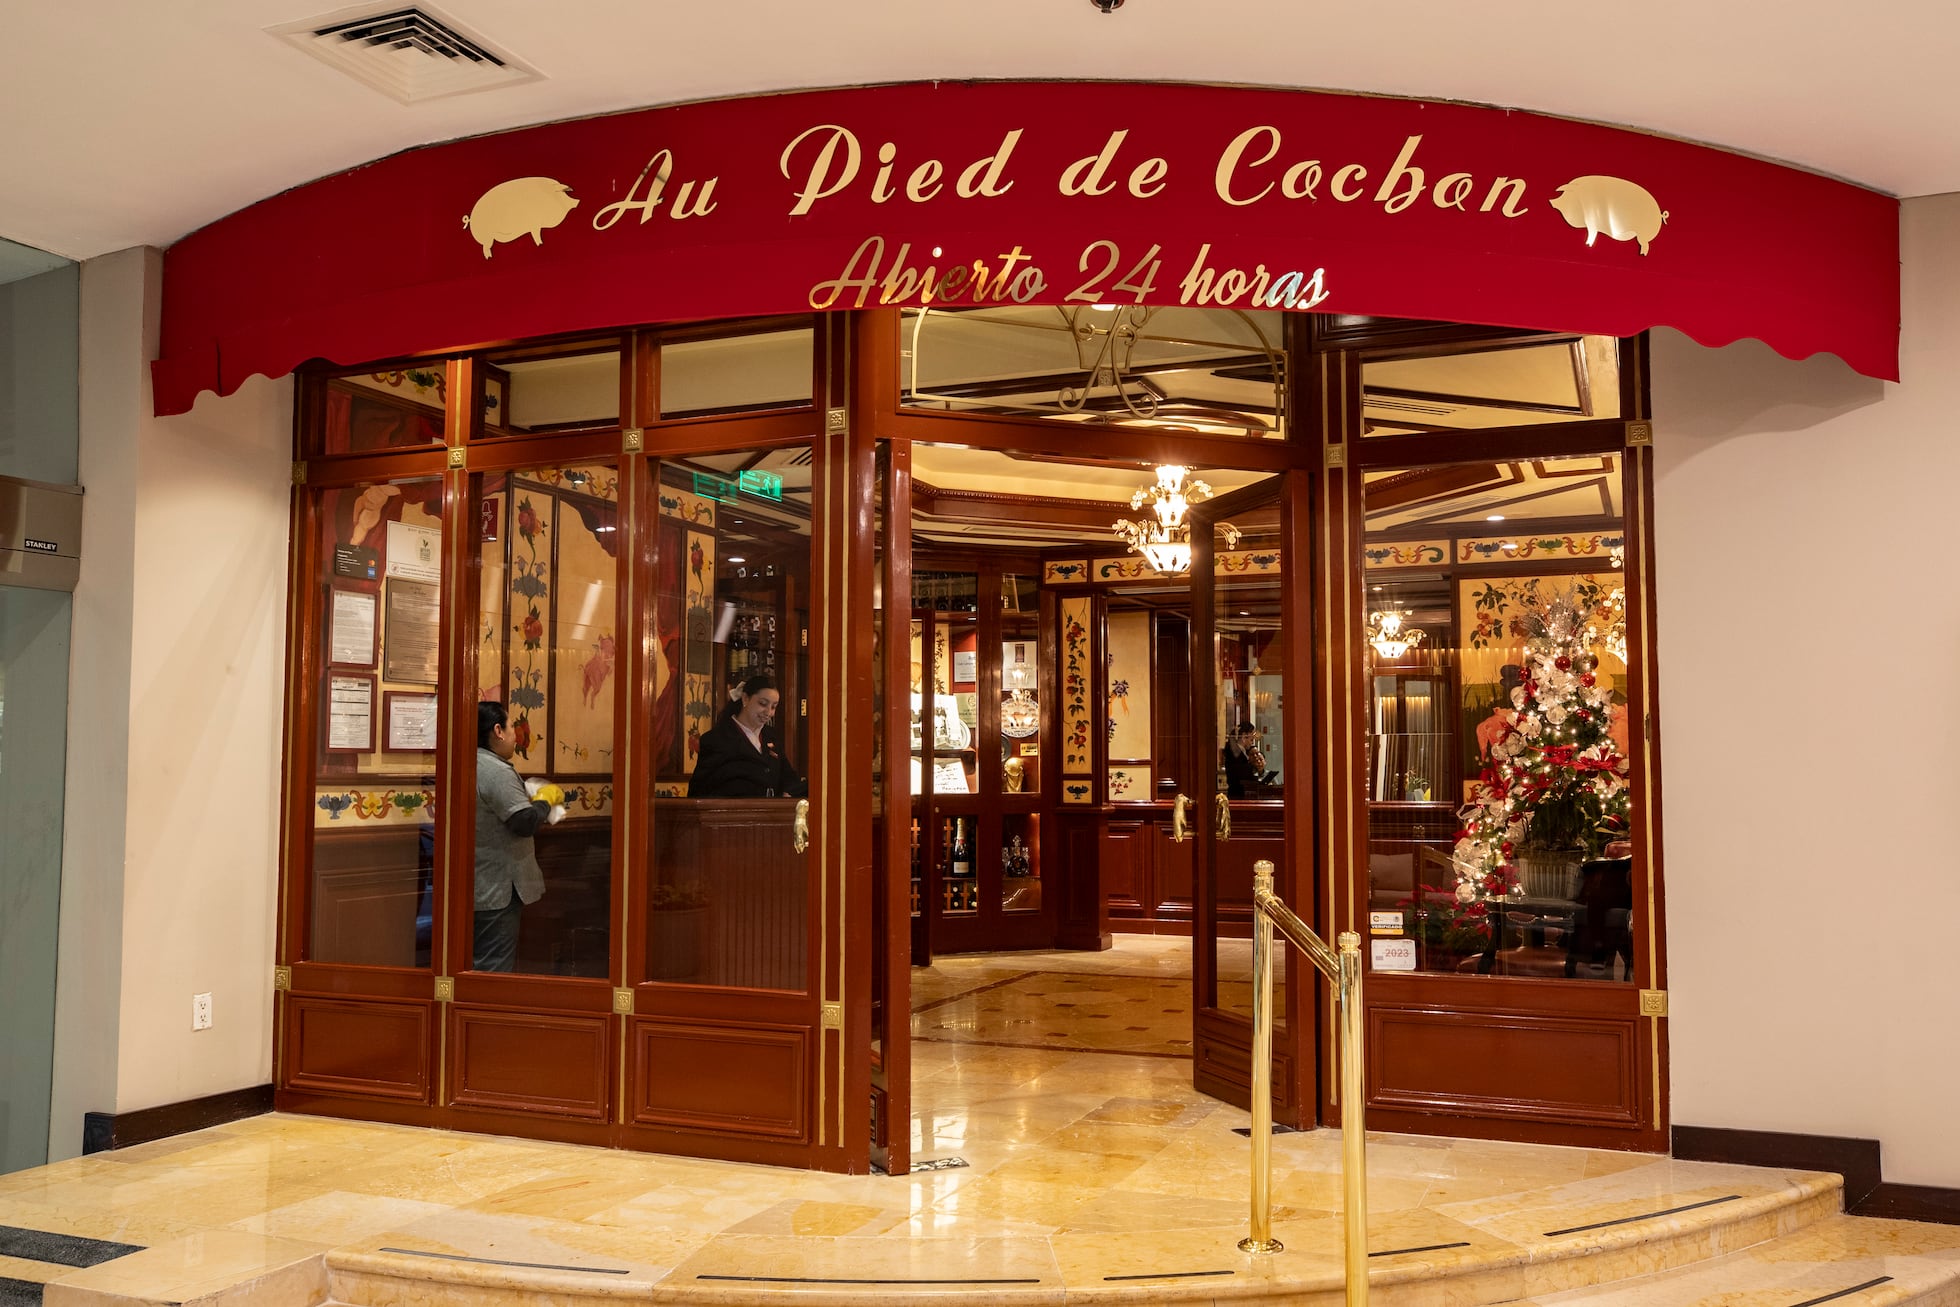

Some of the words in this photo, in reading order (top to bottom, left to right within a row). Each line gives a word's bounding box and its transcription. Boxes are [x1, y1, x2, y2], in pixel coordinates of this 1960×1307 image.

[593, 148, 719, 231] Au
[779, 124, 1024, 217] Pied
[1058, 128, 1170, 199] de
[1214, 125, 1530, 218] Cochon
[808, 235, 1048, 310] Abierto
[1063, 239, 1162, 304] 24
[1178, 243, 1331, 310] horas
[1385, 948, 1409, 958] 2023
